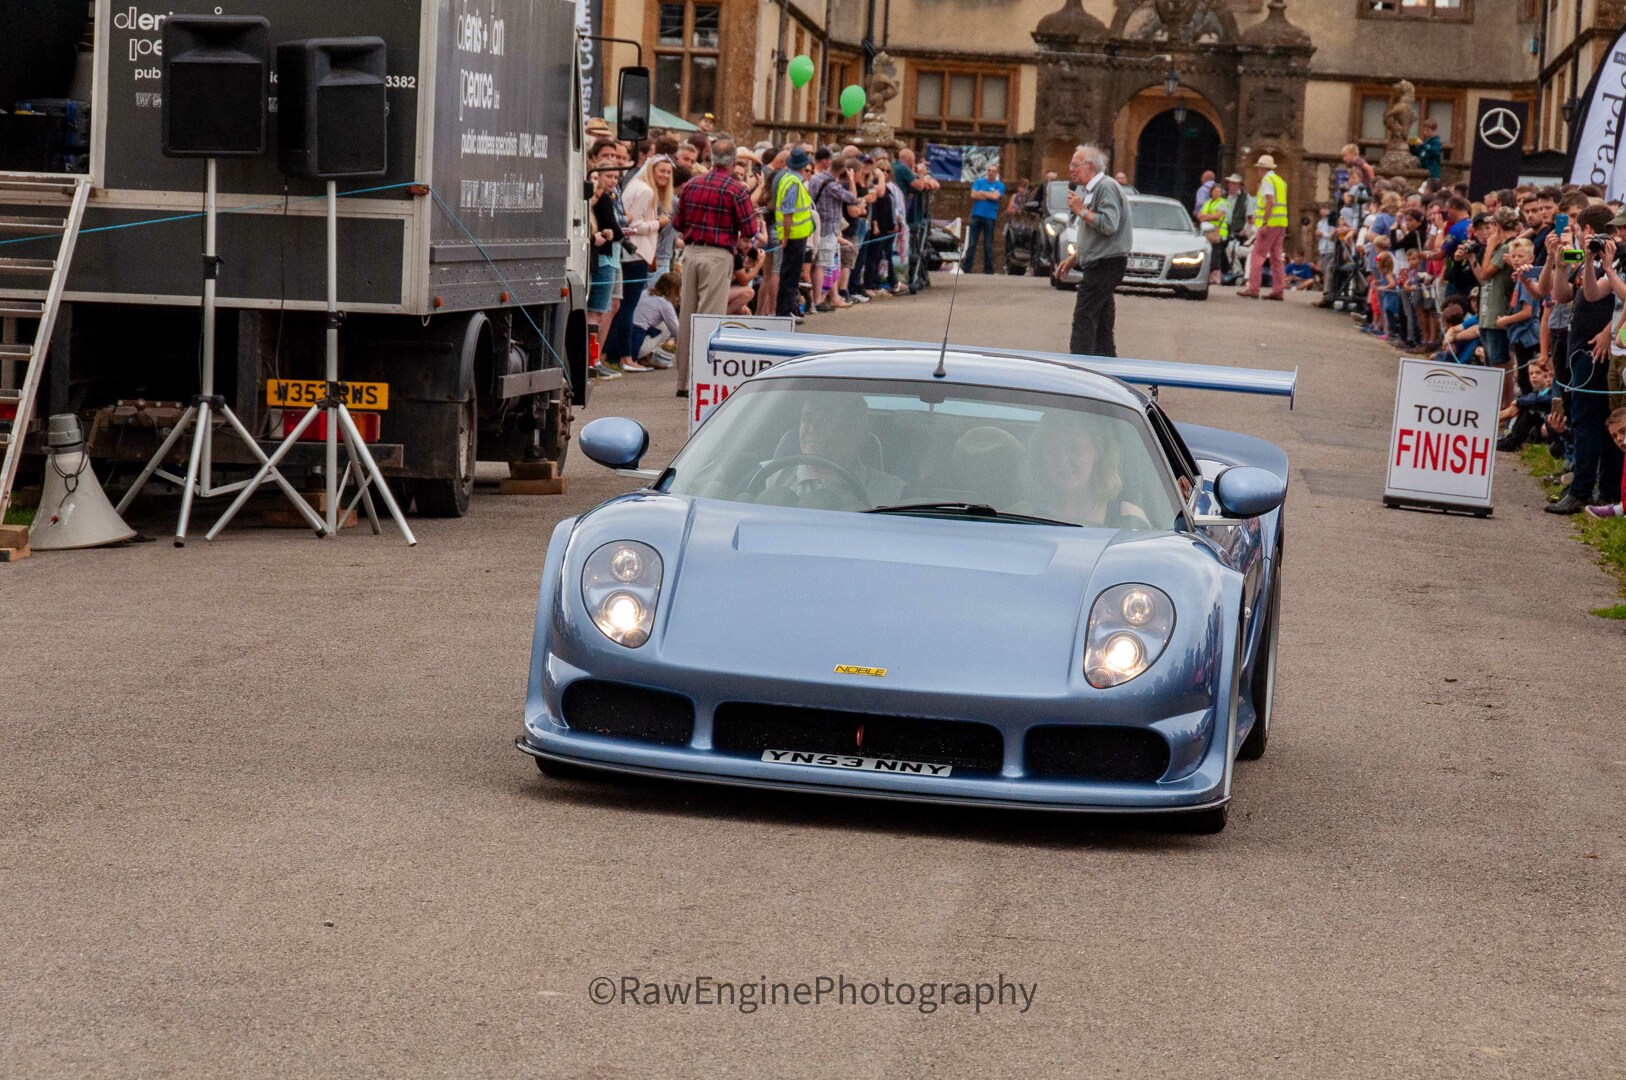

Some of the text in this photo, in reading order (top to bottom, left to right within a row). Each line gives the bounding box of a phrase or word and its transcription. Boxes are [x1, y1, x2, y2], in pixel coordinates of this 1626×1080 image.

[134, 67, 162, 80] pub
[459, 68, 493, 121] pearce
[1590, 70, 1626, 186] gard
[460, 128, 477, 159] public
[476, 129, 495, 155] address
[494, 131, 518, 161] specialists
[1414, 404, 1479, 429] TOUR
[1395, 428, 1490, 476] FINISH
[835, 665, 886, 676] NOBLE
[769, 750, 948, 775] YN53 NNY
